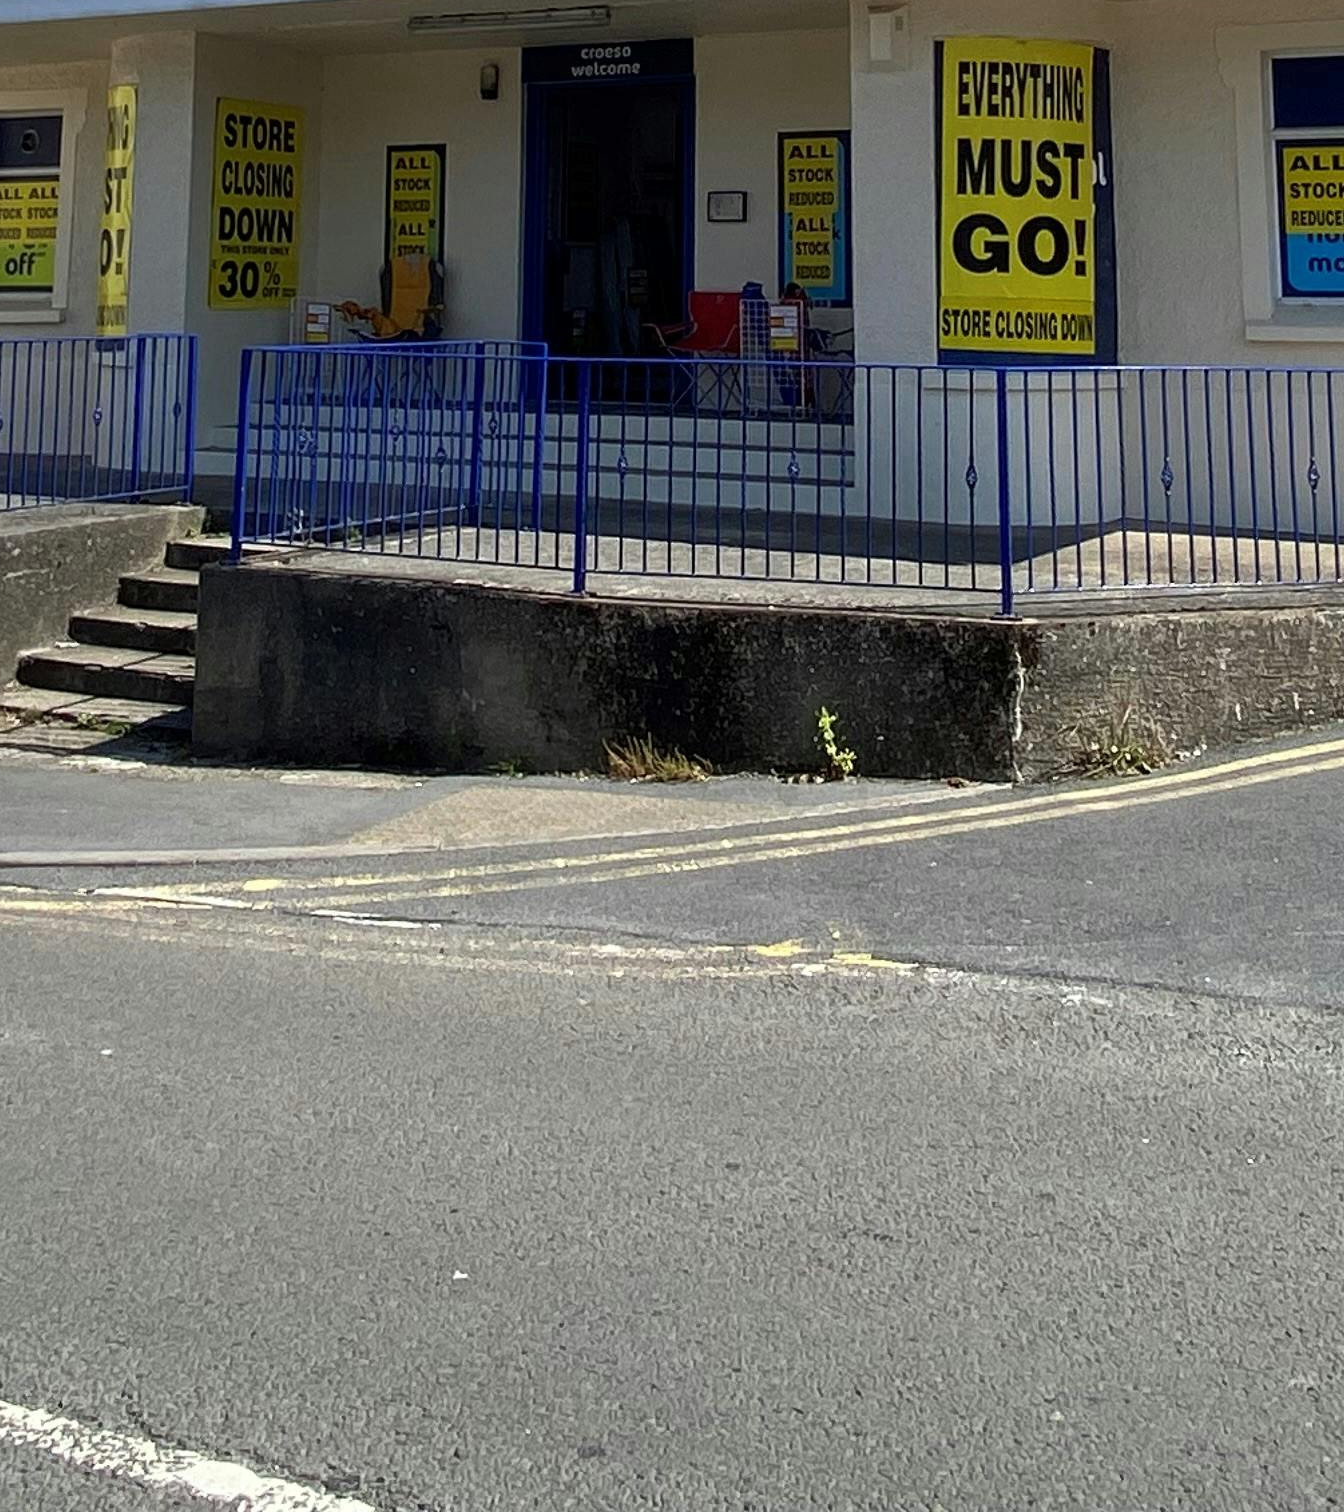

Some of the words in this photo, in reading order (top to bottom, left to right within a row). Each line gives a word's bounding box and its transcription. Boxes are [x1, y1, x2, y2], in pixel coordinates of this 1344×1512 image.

[580, 45, 632, 60] croeso
[570, 61, 641, 77] welcome
[956, 61, 1084, 123] EVERYTHING
[223, 113, 296, 153] STORE
[788, 145, 834, 159] ALL
[395, 157, 431, 170] ALL
[956, 137, 1085, 200] MUST
[221, 159, 294, 199] CLOSING
[788, 168, 834, 183] STOCK
[394, 178, 431, 191] STOCK
[28, 187, 59, 200] ALL
[788, 191, 834, 206] REDUCED
[218, 206, 294, 243] DOWN
[398, 223, 425, 236] ALL
[795, 218, 830, 232] ALL
[795, 242, 830, 256] STOCK
[952, 213, 1087, 277] GO!
[5, 252, 35, 275] off
[795, 265, 831, 279] REDUCED
[263, 287, 280, 297] OFF
[941, 308, 992, 338] STORE
[995, 311, 1058, 341] CLOSING
[1061, 314, 1093, 342] DOWN
